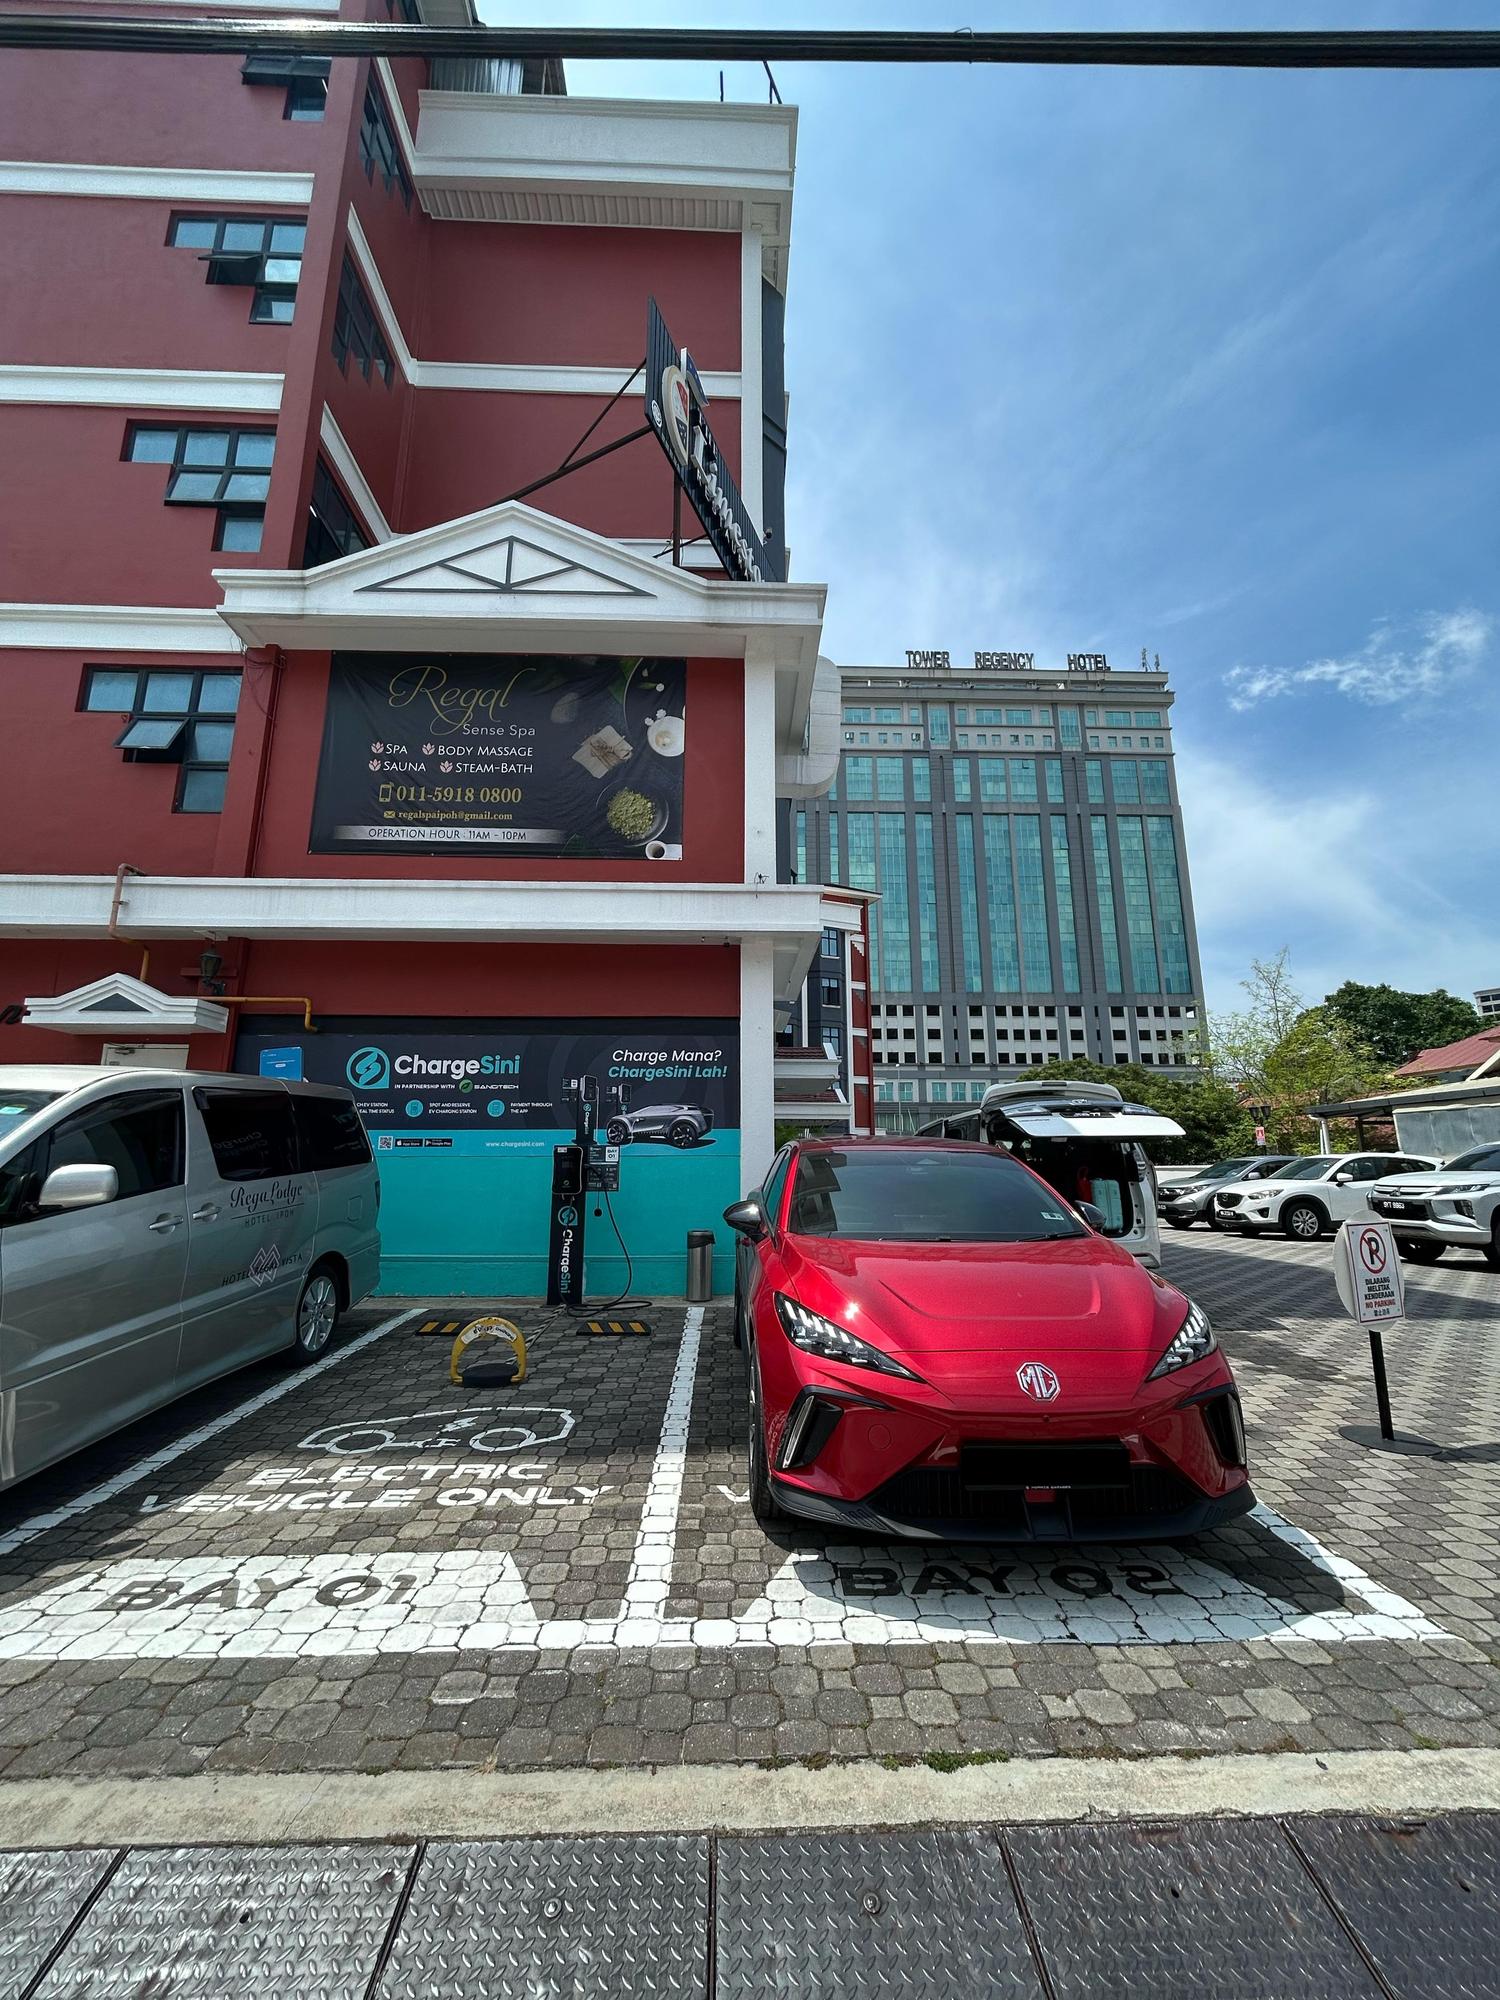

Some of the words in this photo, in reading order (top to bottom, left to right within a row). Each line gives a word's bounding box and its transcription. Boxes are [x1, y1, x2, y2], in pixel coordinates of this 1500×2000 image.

[905, 650, 950, 668] TOWER
[974, 651, 1034, 670] REGENCY
[1067, 653, 1112, 671] HOTEL
[388, 665, 536, 736] Regal
[462, 723, 504, 736] Sense
[509, 724, 536, 738] Spa
[385, 743, 408, 755] SPA
[437, 745, 474, 756] BODY
[477, 746, 534, 757] MASSAGE
[383, 761, 427, 772] SAUNA
[455, 762, 534, 774] STEAM-BATH
[395, 786, 475, 803] 011-5918
[479, 787, 523, 803] 0800
[398, 809, 513, 821] regalspaipoh@gmail.com
[368, 828, 426, 839] OPERATION
[429, 829, 461, 839] HOUR
[468, 830, 491, 840] 11AM
[501, 830, 527, 841] 10PM
[612, 1049, 668, 1065] Charge
[672, 1050, 722, 1062] Mana?
[394, 1054, 521, 1080] ChargeSini
[608, 1065, 694, 1081] ChargeSini
[695, 1065, 728, 1078] Lah!
[244, 1213, 272, 1227] HOTEL
[560, 1229, 573, 1294] ChargeSini
[222, 1270, 251, 1287] HOTEL
[281, 1253, 303, 1267] VISTA
[1364, 1277, 1391, 1286] DILARANG
[1367, 1285, 1391, 1293] MELETAK
[1364, 1291, 1395, 1300] KENDERAAN
[1365, 1300, 1374, 1308] NO
[1374, 1299, 1396, 1308] PARKING
[1018, 1363, 1058, 1400] MG
[246, 1463, 549, 1485] ELECTRIC
[139, 1487, 420, 1513] VEHICLE
[435, 1485, 614, 1507] ONLY
[838, 1564, 1017, 1597] BAY
[1050, 1564, 1184, 1596] 02
[110, 1573, 308, 1611] BAY
[314, 1573, 419, 1607] 01
